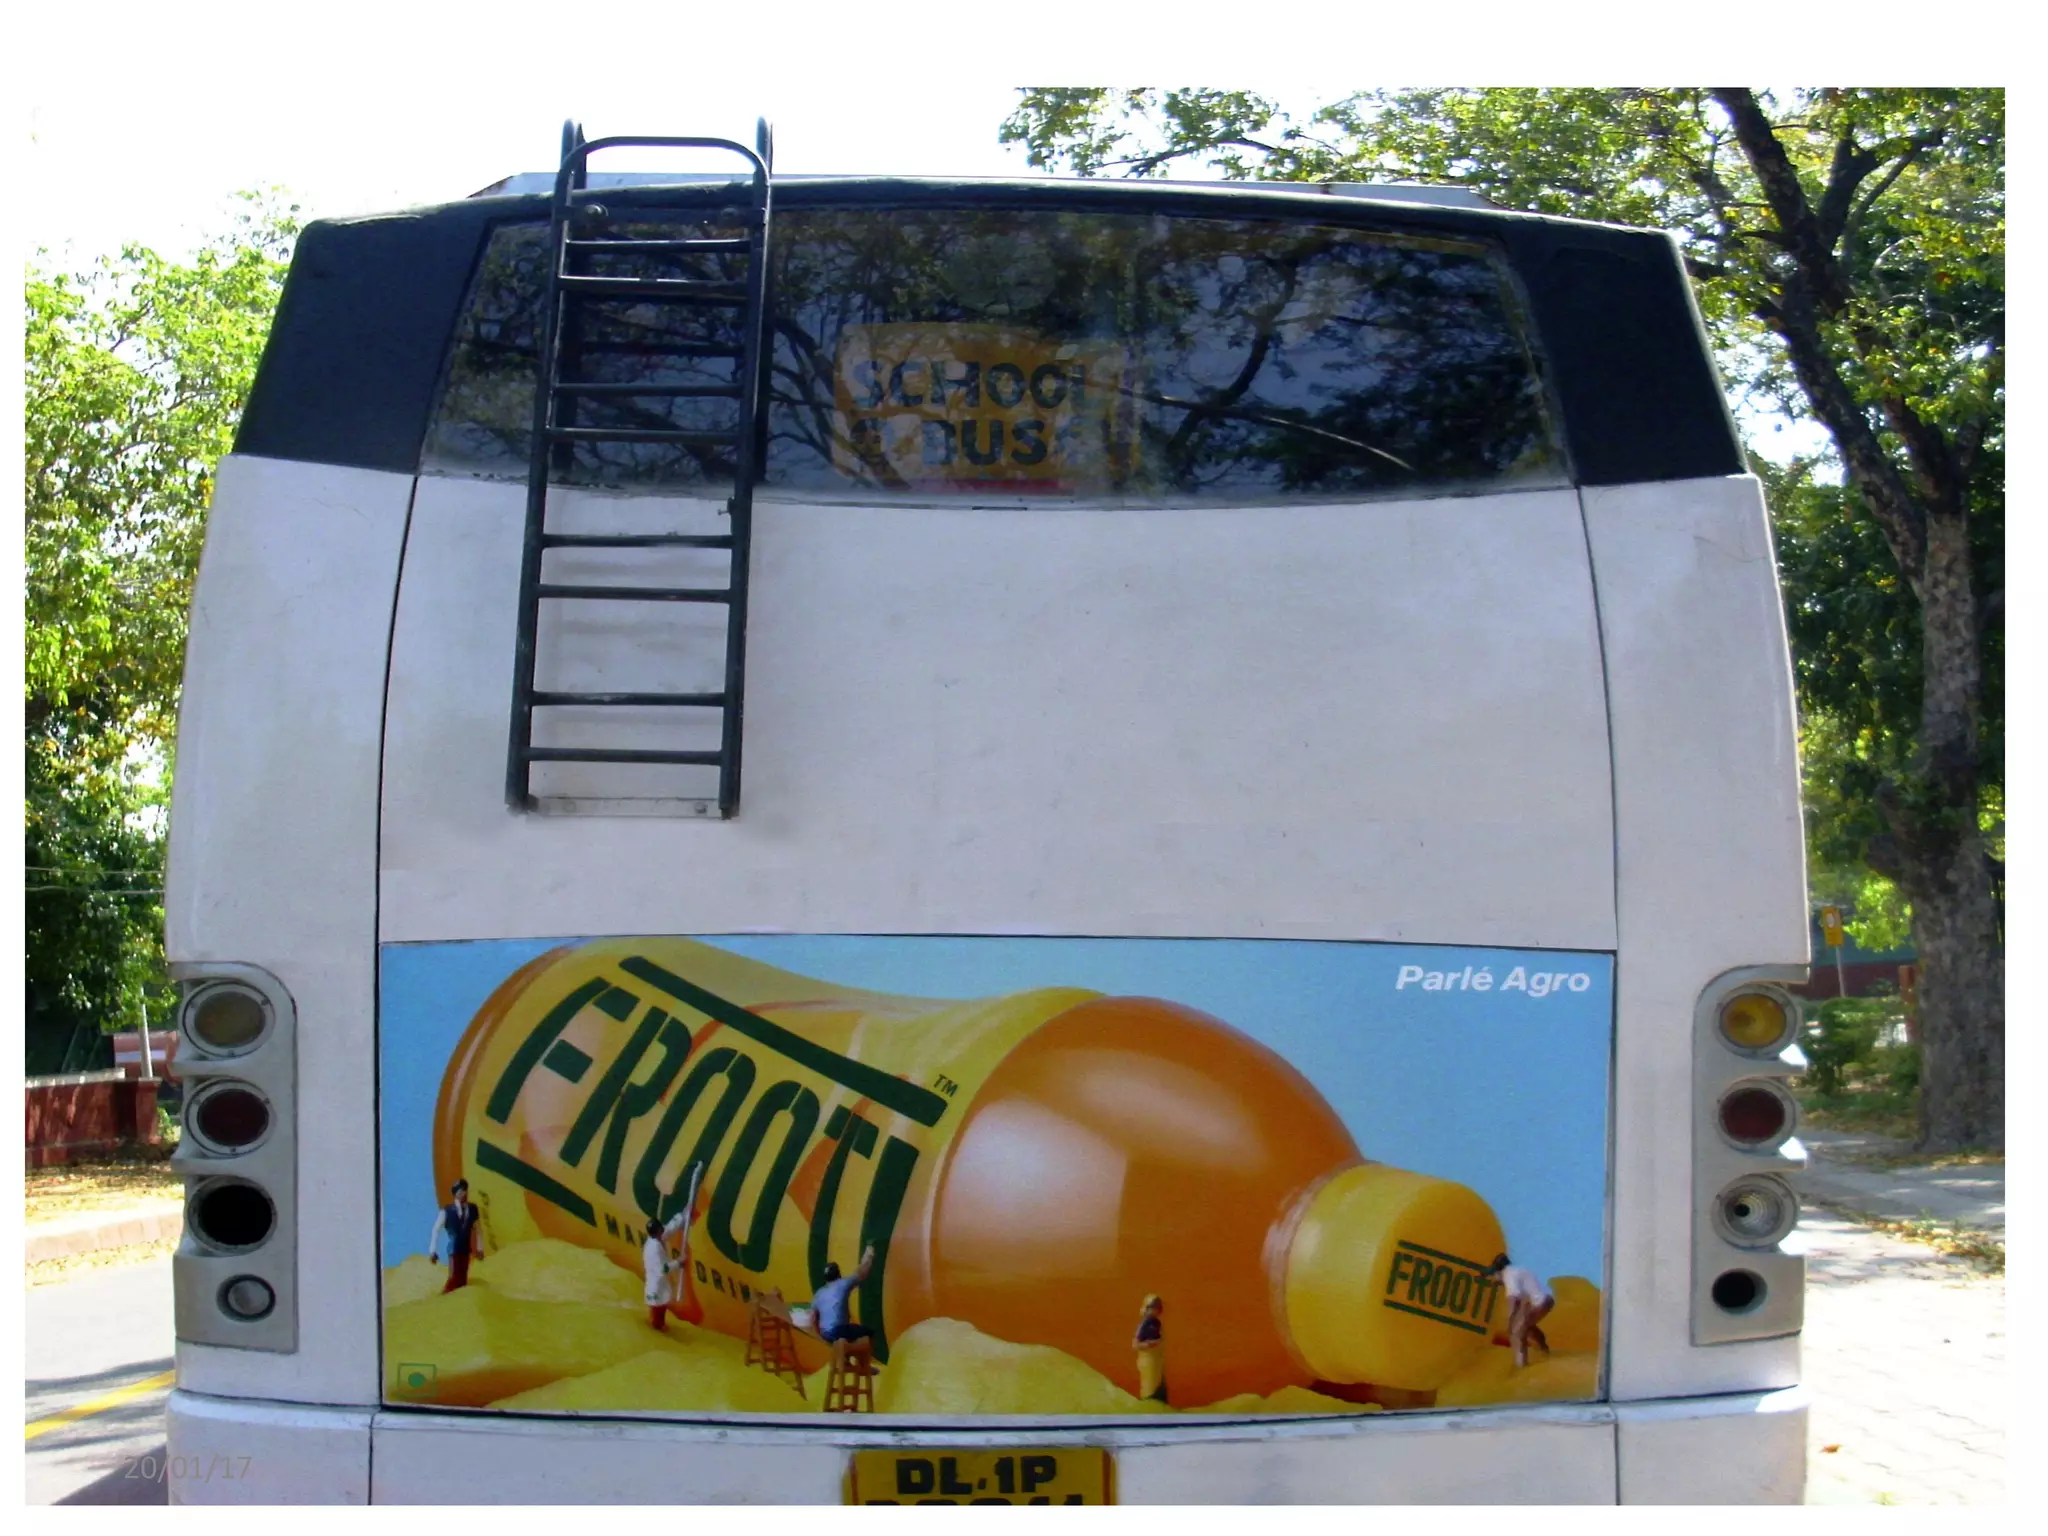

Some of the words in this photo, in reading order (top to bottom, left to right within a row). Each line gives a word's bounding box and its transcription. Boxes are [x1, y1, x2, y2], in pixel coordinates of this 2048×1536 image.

[922, 418, 1048, 468] BUS
[1395, 965, 1494, 992] Parlé
[1499, 966, 1591, 998] Agro
[485, 976, 920, 1365] FROOTI
[1386, 1251, 1499, 1323] FROOTI
